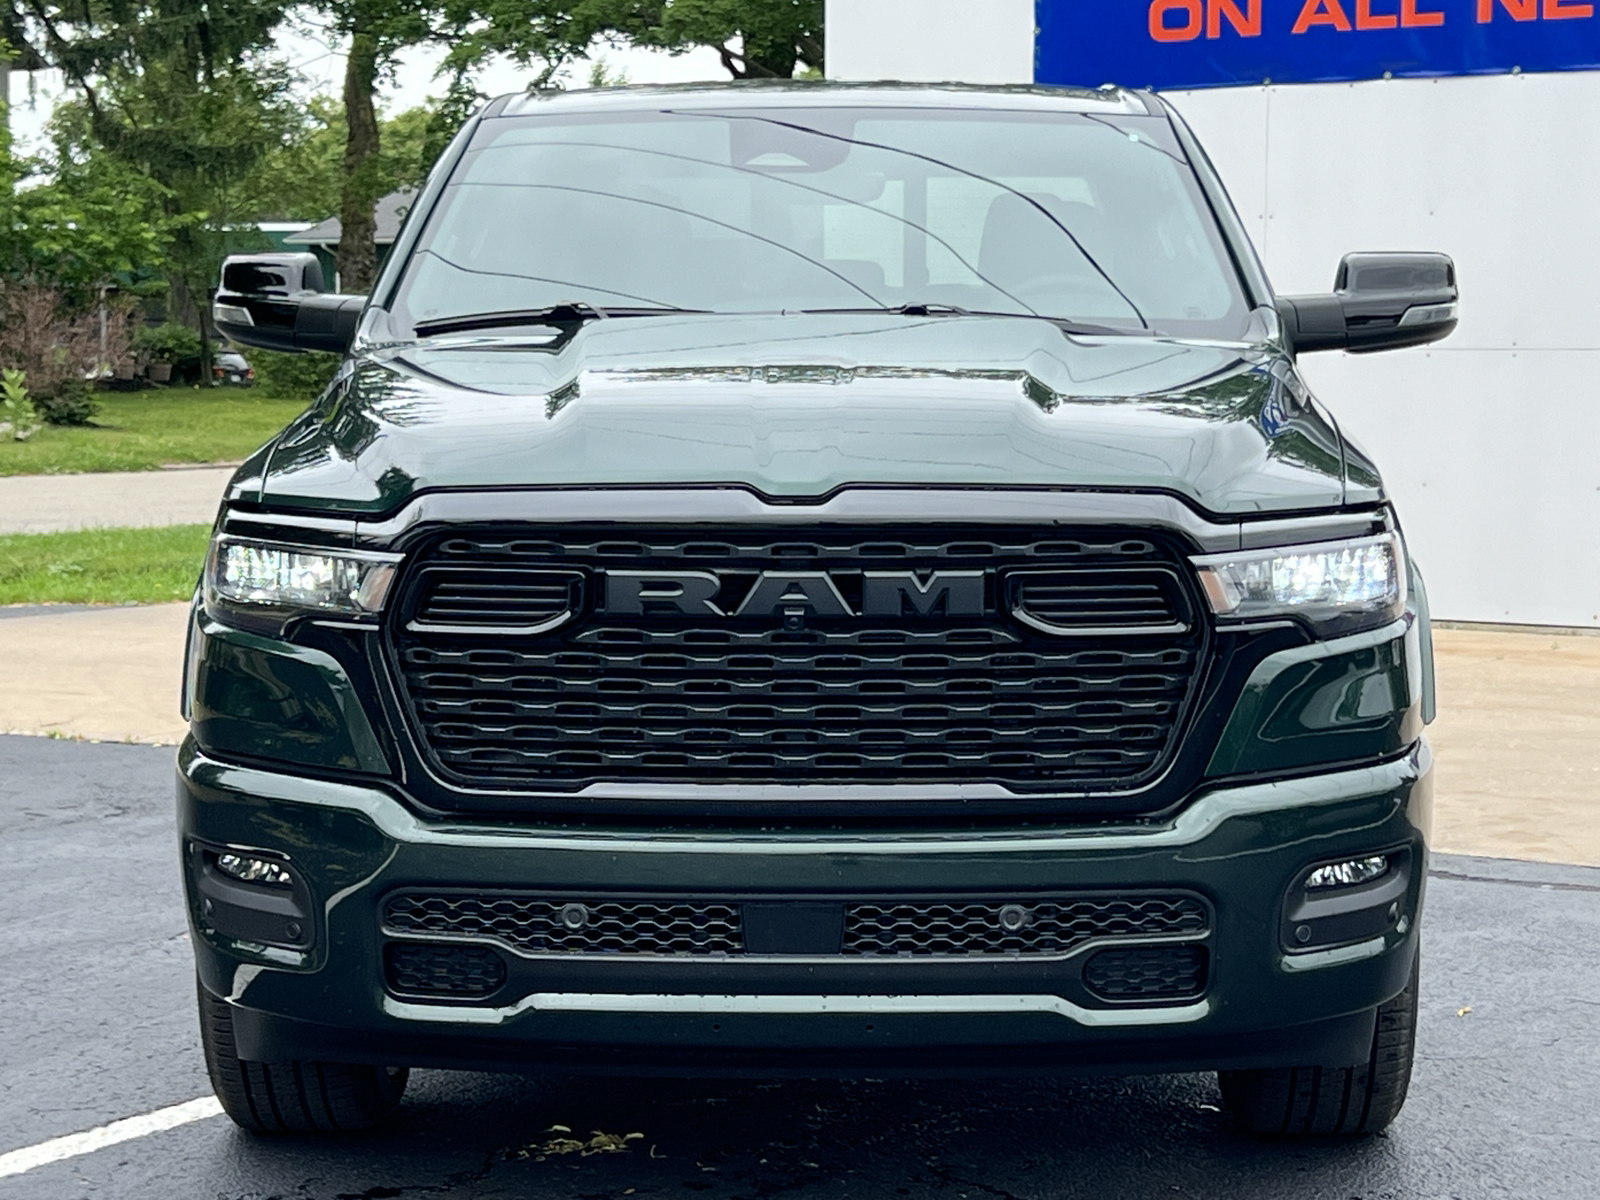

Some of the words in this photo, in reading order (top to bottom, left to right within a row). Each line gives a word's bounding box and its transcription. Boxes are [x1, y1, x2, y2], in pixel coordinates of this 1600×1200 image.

[1149, 0, 1262, 42] ON
[1291, 0, 1445, 34] ALL
[605, 570, 985, 617] RAM
